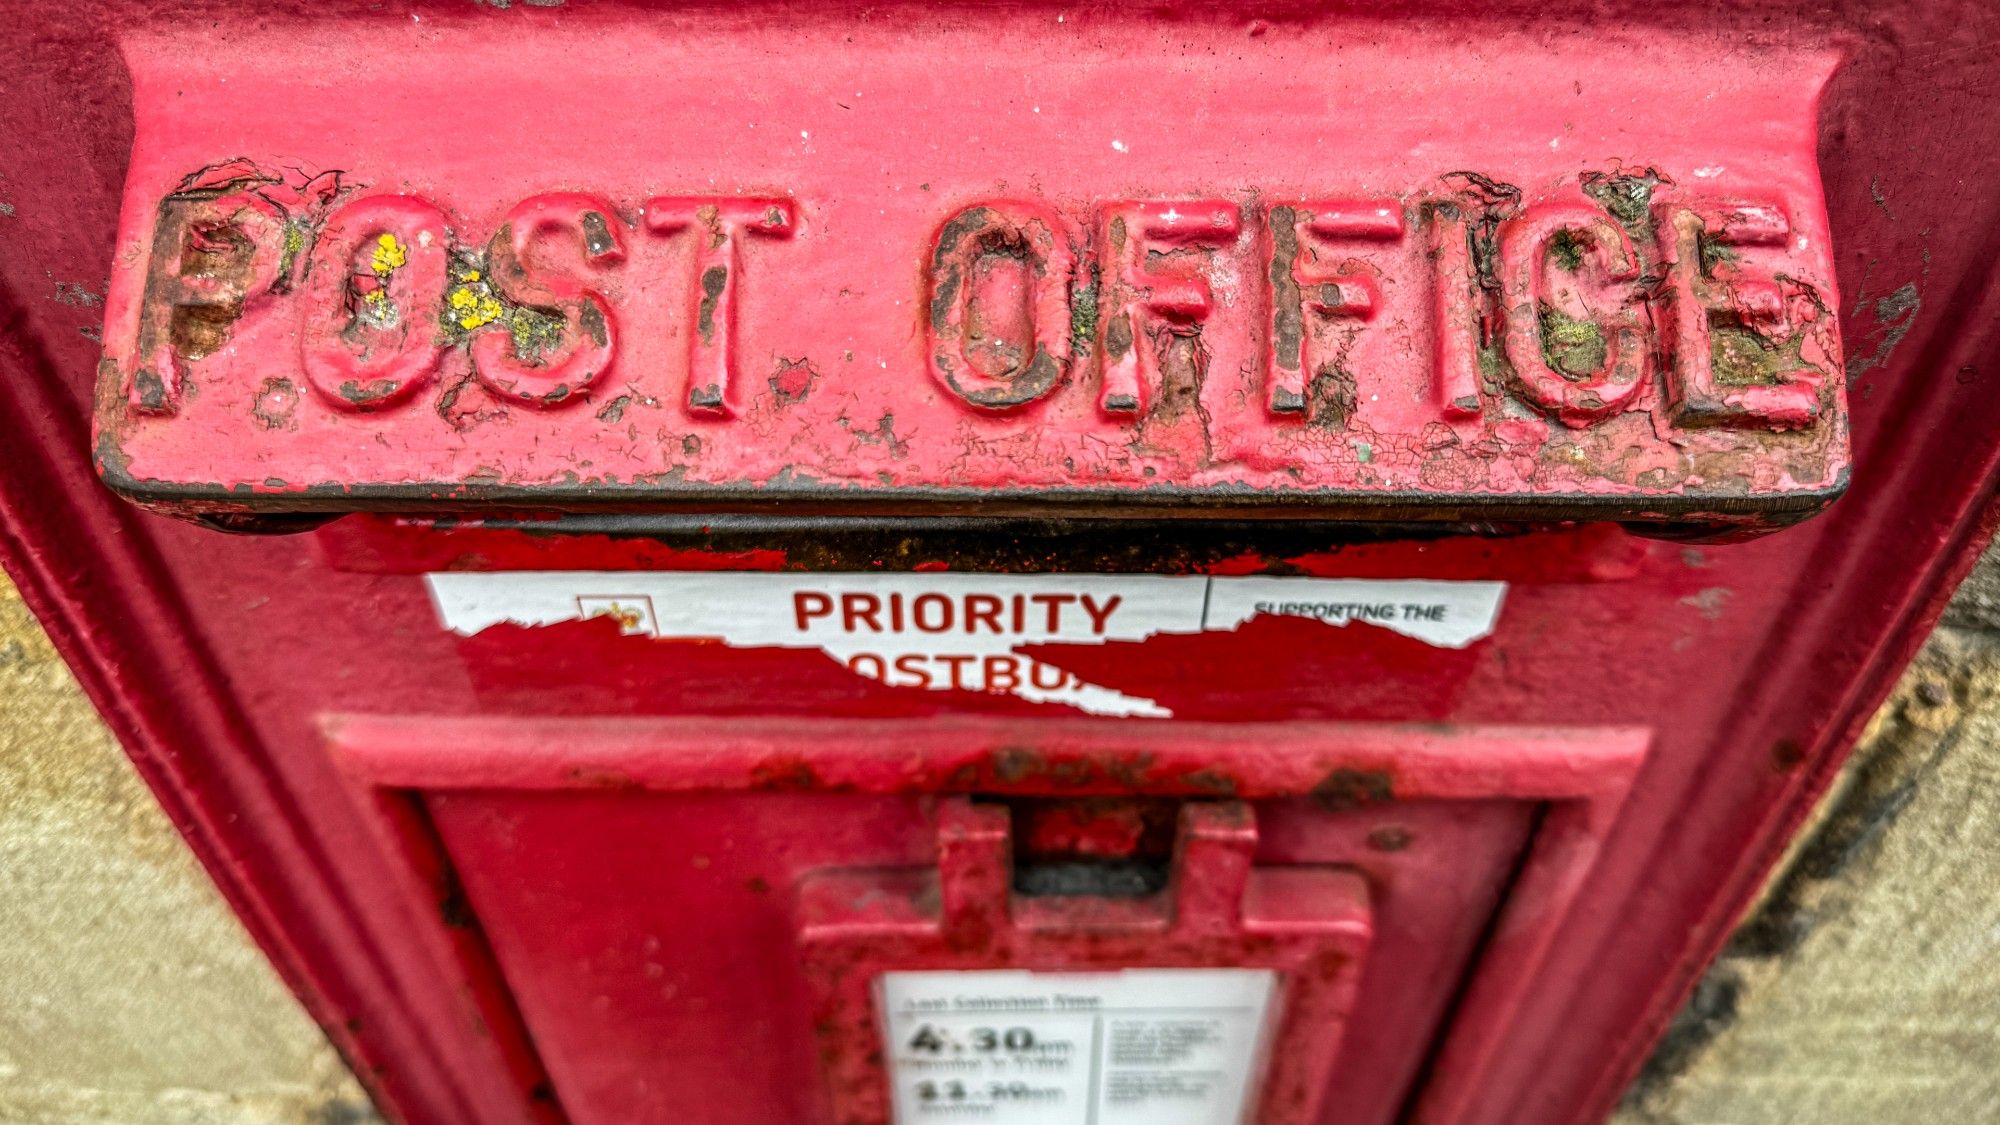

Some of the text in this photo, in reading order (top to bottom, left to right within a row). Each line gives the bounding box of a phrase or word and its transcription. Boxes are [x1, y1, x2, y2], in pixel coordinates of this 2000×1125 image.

[130, 190, 1822, 428] POST OFFICE
[793, 591, 1122, 635] PRIORITY
[1401, 604, 1447, 622] THE
